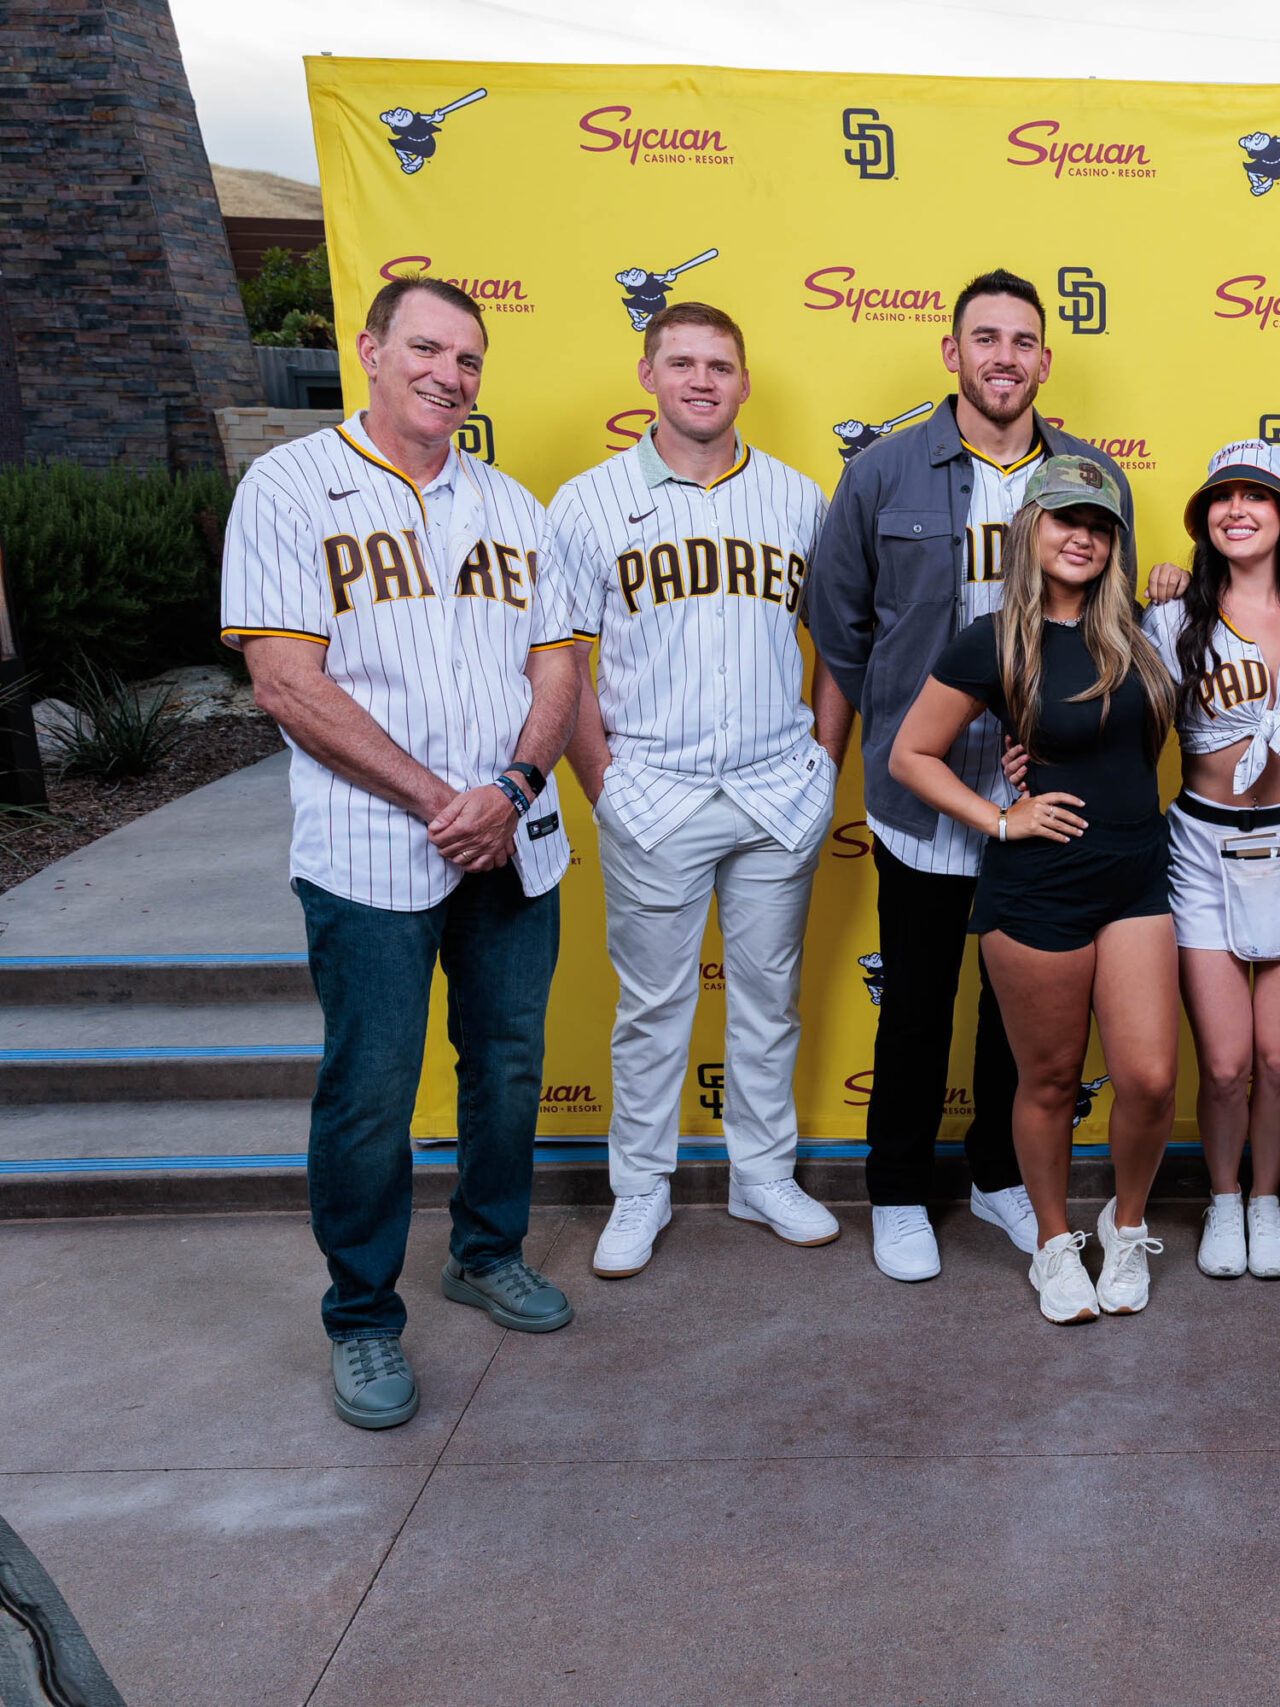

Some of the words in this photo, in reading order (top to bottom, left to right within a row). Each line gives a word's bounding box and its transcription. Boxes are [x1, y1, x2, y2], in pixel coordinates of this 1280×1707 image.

[578, 105, 728, 166] Sycuan
[1006, 120, 1151, 179] Sycuan
[643, 153, 686, 164] CASINO
[695, 155, 735, 166] RESORT
[1068, 167, 1109, 178] CASINO
[1118, 168, 1157, 179] RESORT
[803, 266, 947, 324] Sycuan
[495, 303, 536, 313] RESORT
[865, 312, 906, 322] CASINO
[914, 313, 953, 324] RESORT
[1215, 442, 1265, 466] PADRES
[1119, 461, 1157, 470] RESORT
[616, 536, 807, 616] PADRES
[566, 1104, 602, 1113] RESORT
